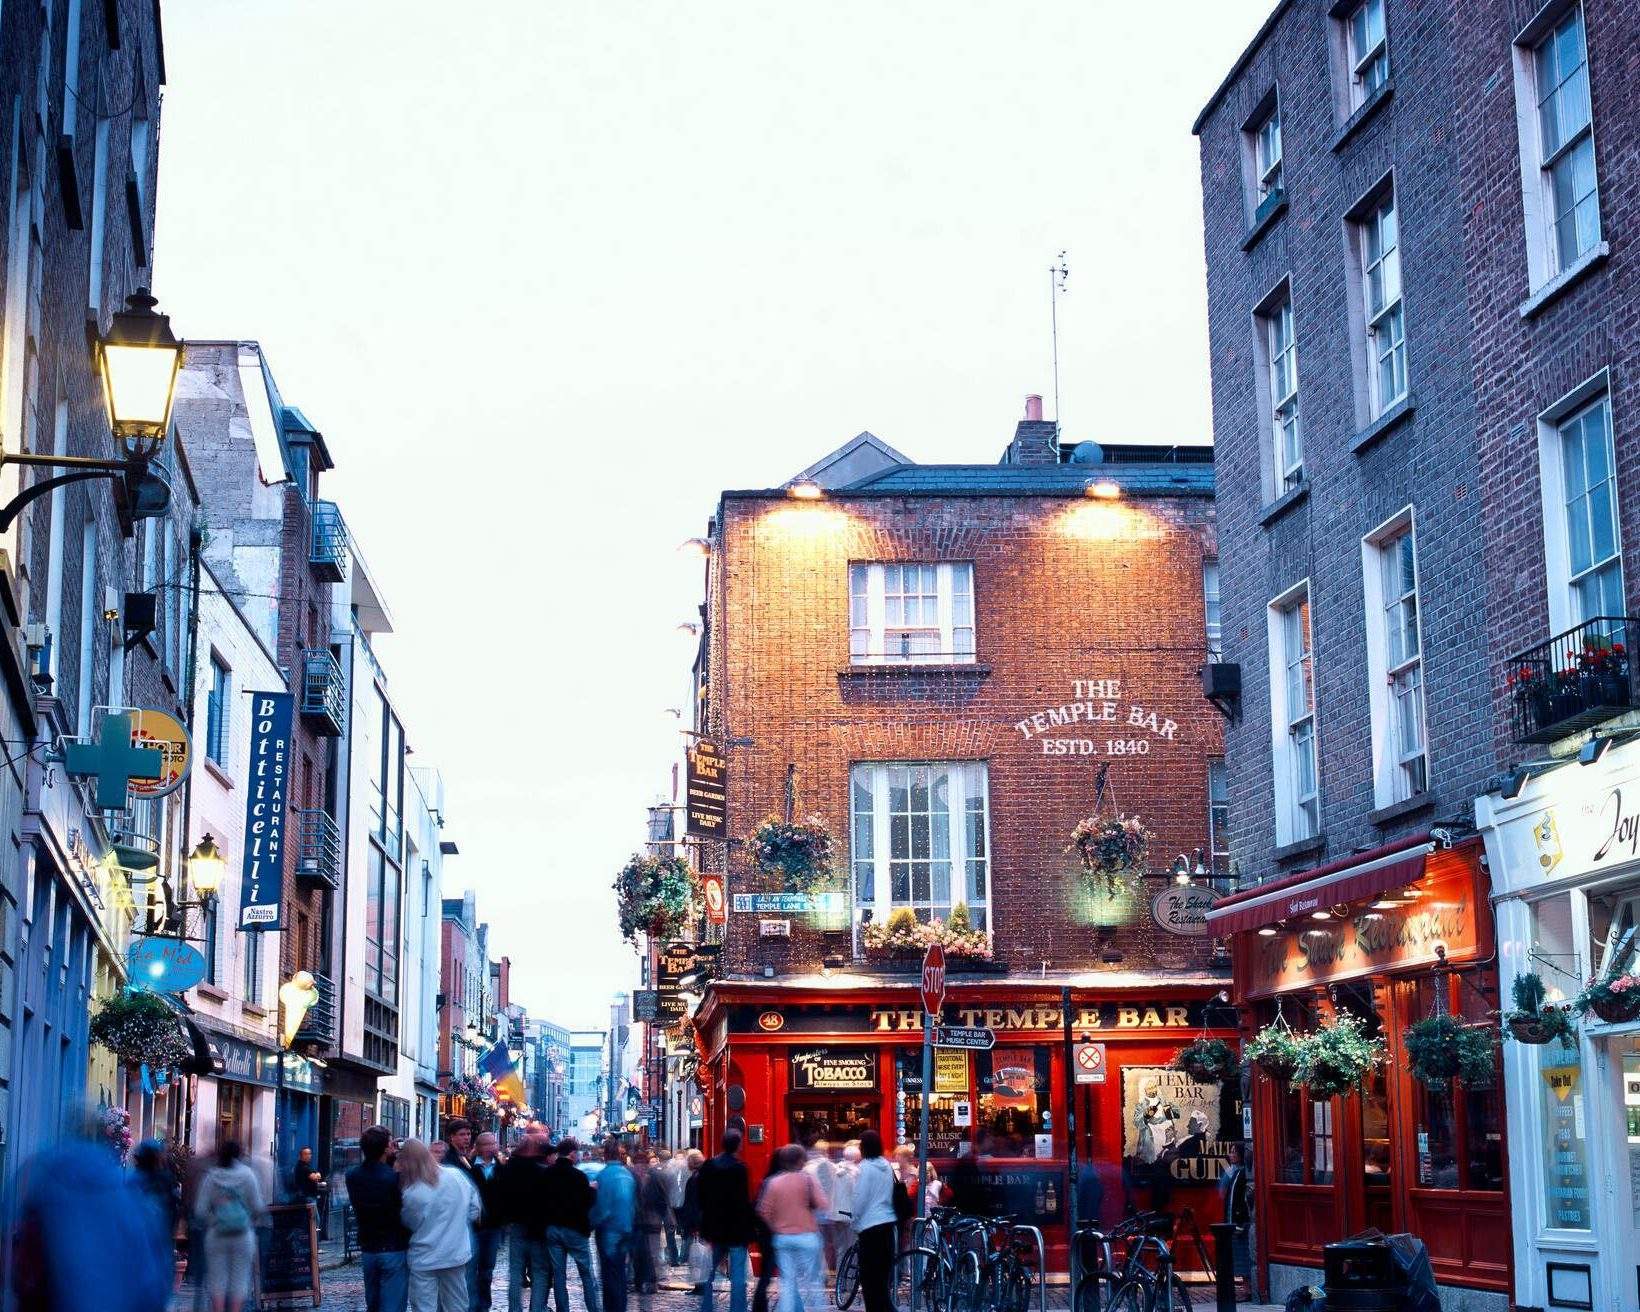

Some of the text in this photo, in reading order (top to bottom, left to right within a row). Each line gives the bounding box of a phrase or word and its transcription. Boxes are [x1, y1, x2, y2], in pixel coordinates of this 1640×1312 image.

[1071, 680, 1121, 698] THE
[1015, 701, 1178, 740] TEMPLE BAR
[701, 743, 715, 753] THE
[1043, 739, 1150, 755] ESTD. 1840
[688, 751, 726, 769] TEMPLE
[696, 764, 718, 778] BAR
[250, 698, 276, 903] Botticelli
[269, 739, 285, 864] RESTAURANT
[691, 811, 723, 823] LIVE MUSIC
[699, 819, 716, 828] DAILY
[923, 966, 944, 993] STOP
[763, 1014, 779, 1027] 48
[1117, 1007, 1189, 1027] BAR
[946, 1037, 990, 1046] MUSIC CENTRE
[951, 1030, 986, 1039] TEMPLE BAR
[802, 1062, 867, 1085] TOBACCO
[1174, 1086, 1204, 1099] BAR
[937, 1131, 963, 1141] MUSIC
